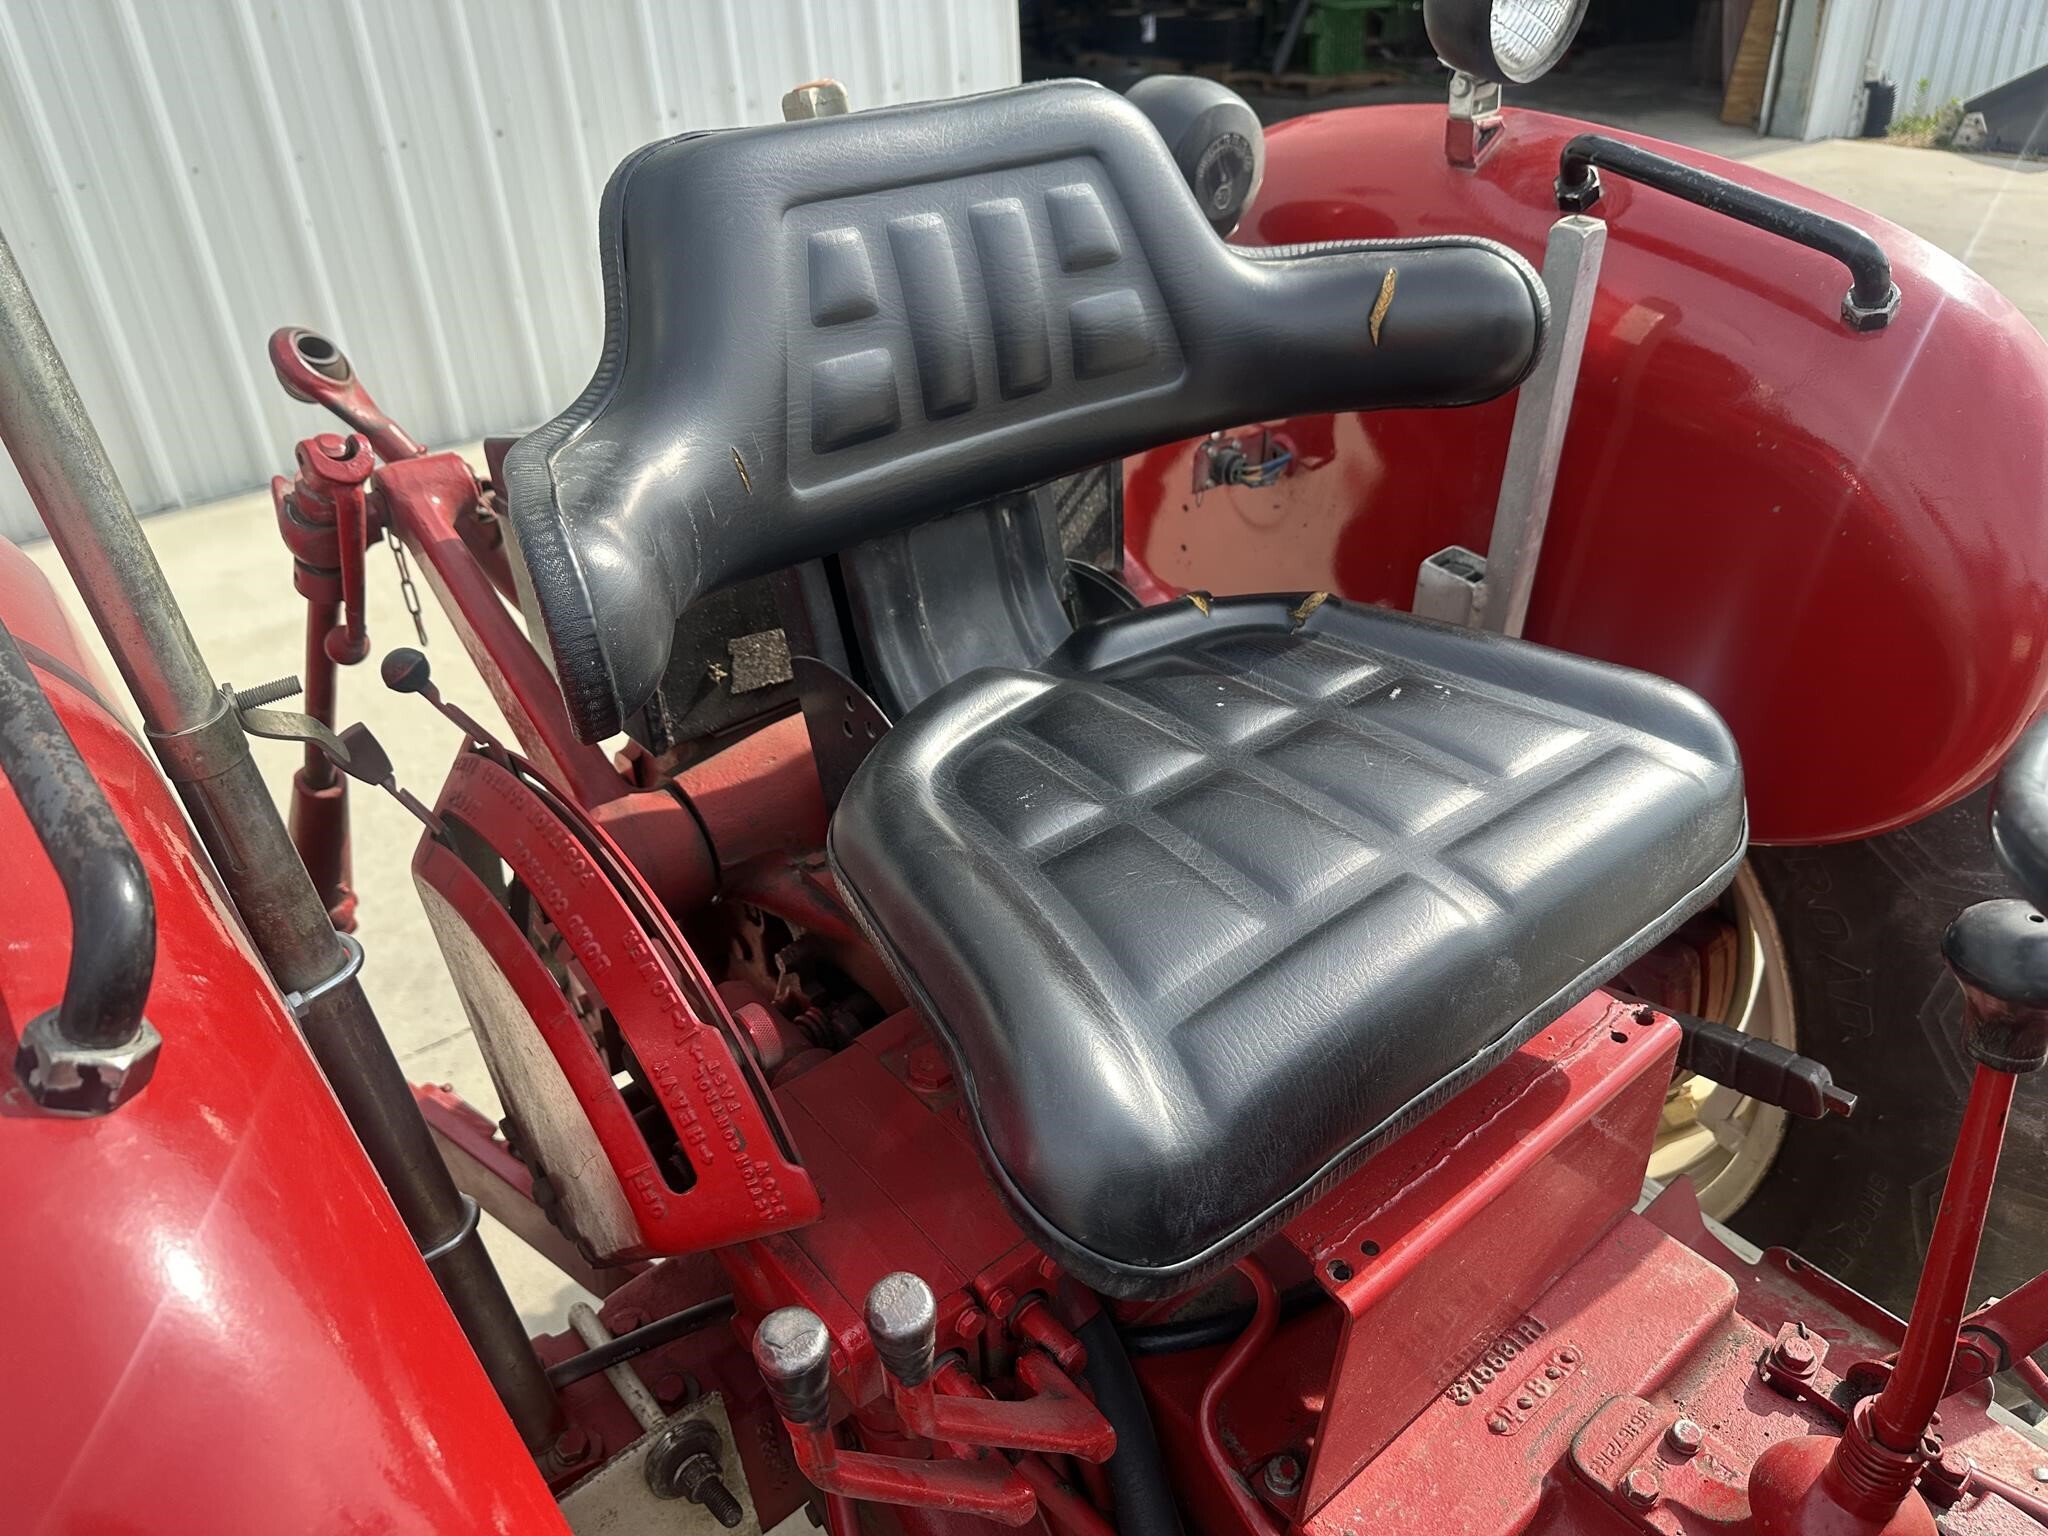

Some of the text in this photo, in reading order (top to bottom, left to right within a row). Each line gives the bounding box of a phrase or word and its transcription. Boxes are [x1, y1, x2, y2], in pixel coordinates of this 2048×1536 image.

[622, 928, 680, 1013] LOWER
[652, 1060, 708, 1147] HEAVY
[692, 1066, 743, 1152] CONTROL
[705, 1058, 743, 1112] FAST
[631, 1174, 670, 1219] OFF
